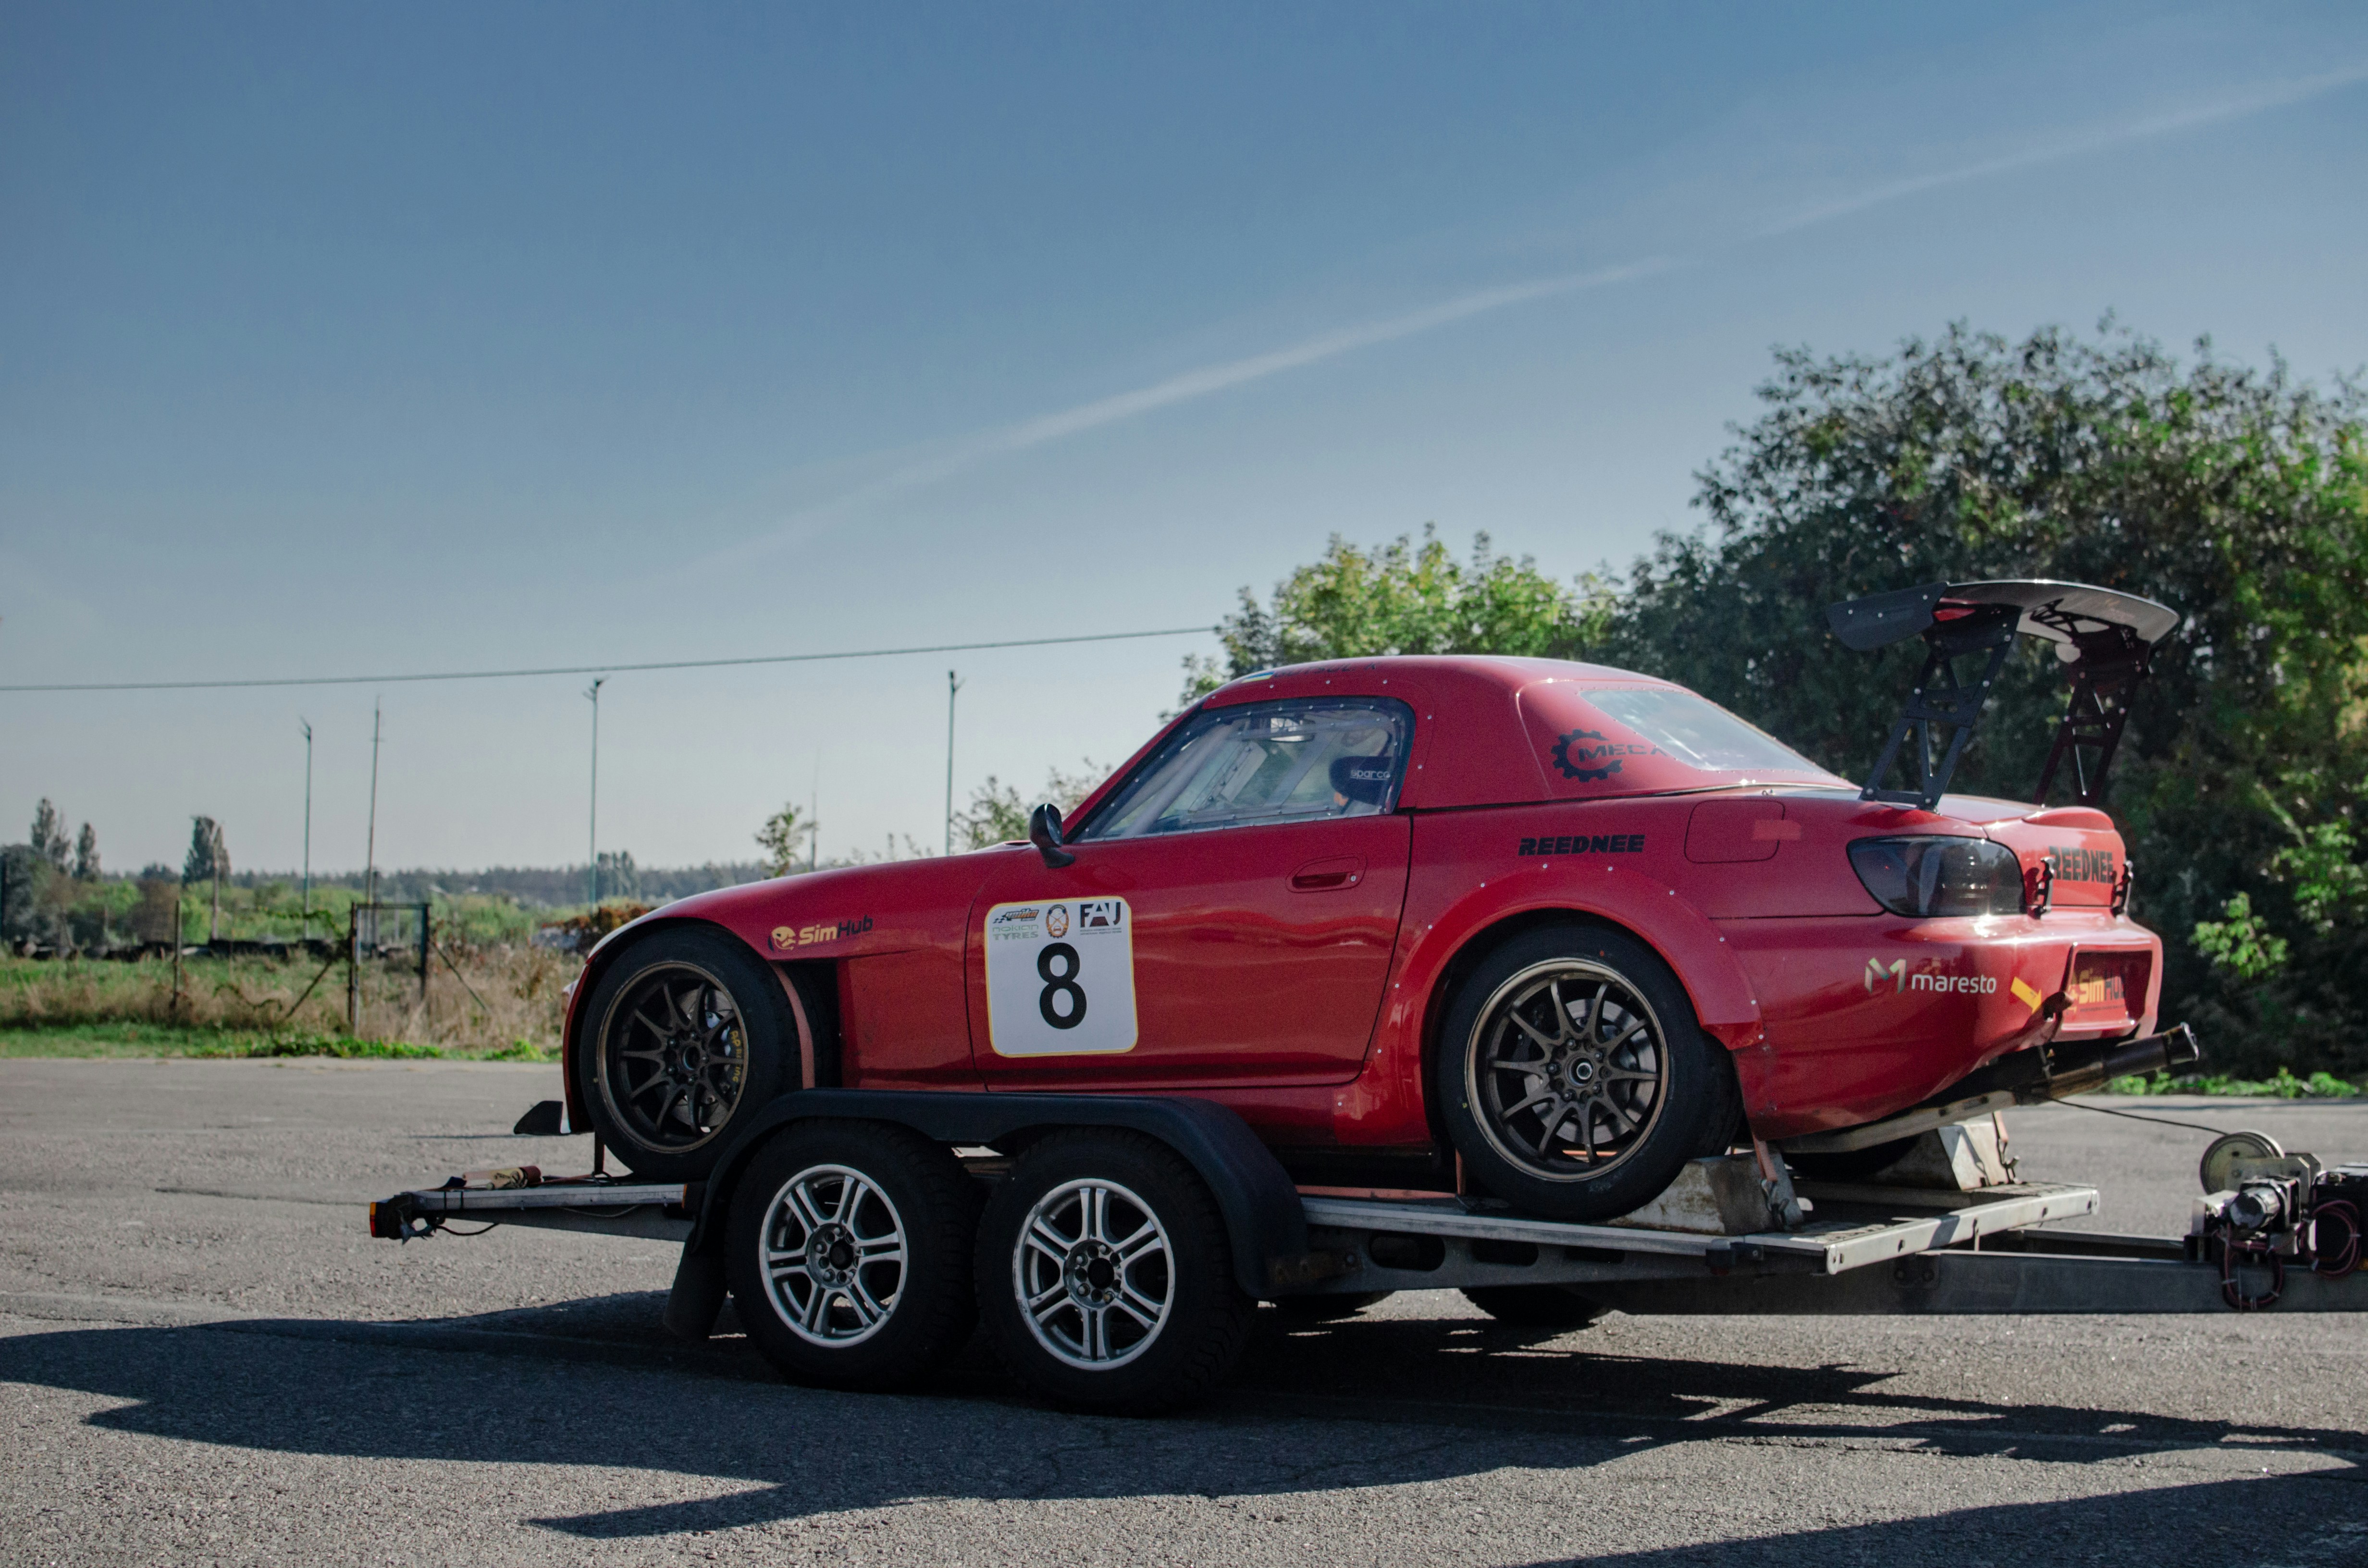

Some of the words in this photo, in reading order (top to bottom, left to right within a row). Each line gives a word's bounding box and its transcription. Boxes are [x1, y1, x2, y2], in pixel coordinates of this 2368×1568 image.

[1518, 834, 1645, 856] REEDNEE
[798, 914, 873, 945] SimHub
[993, 931, 1039, 941] TYRES
[1037, 942, 1087, 1029] 8
[1911, 974, 1997, 994] maresto
